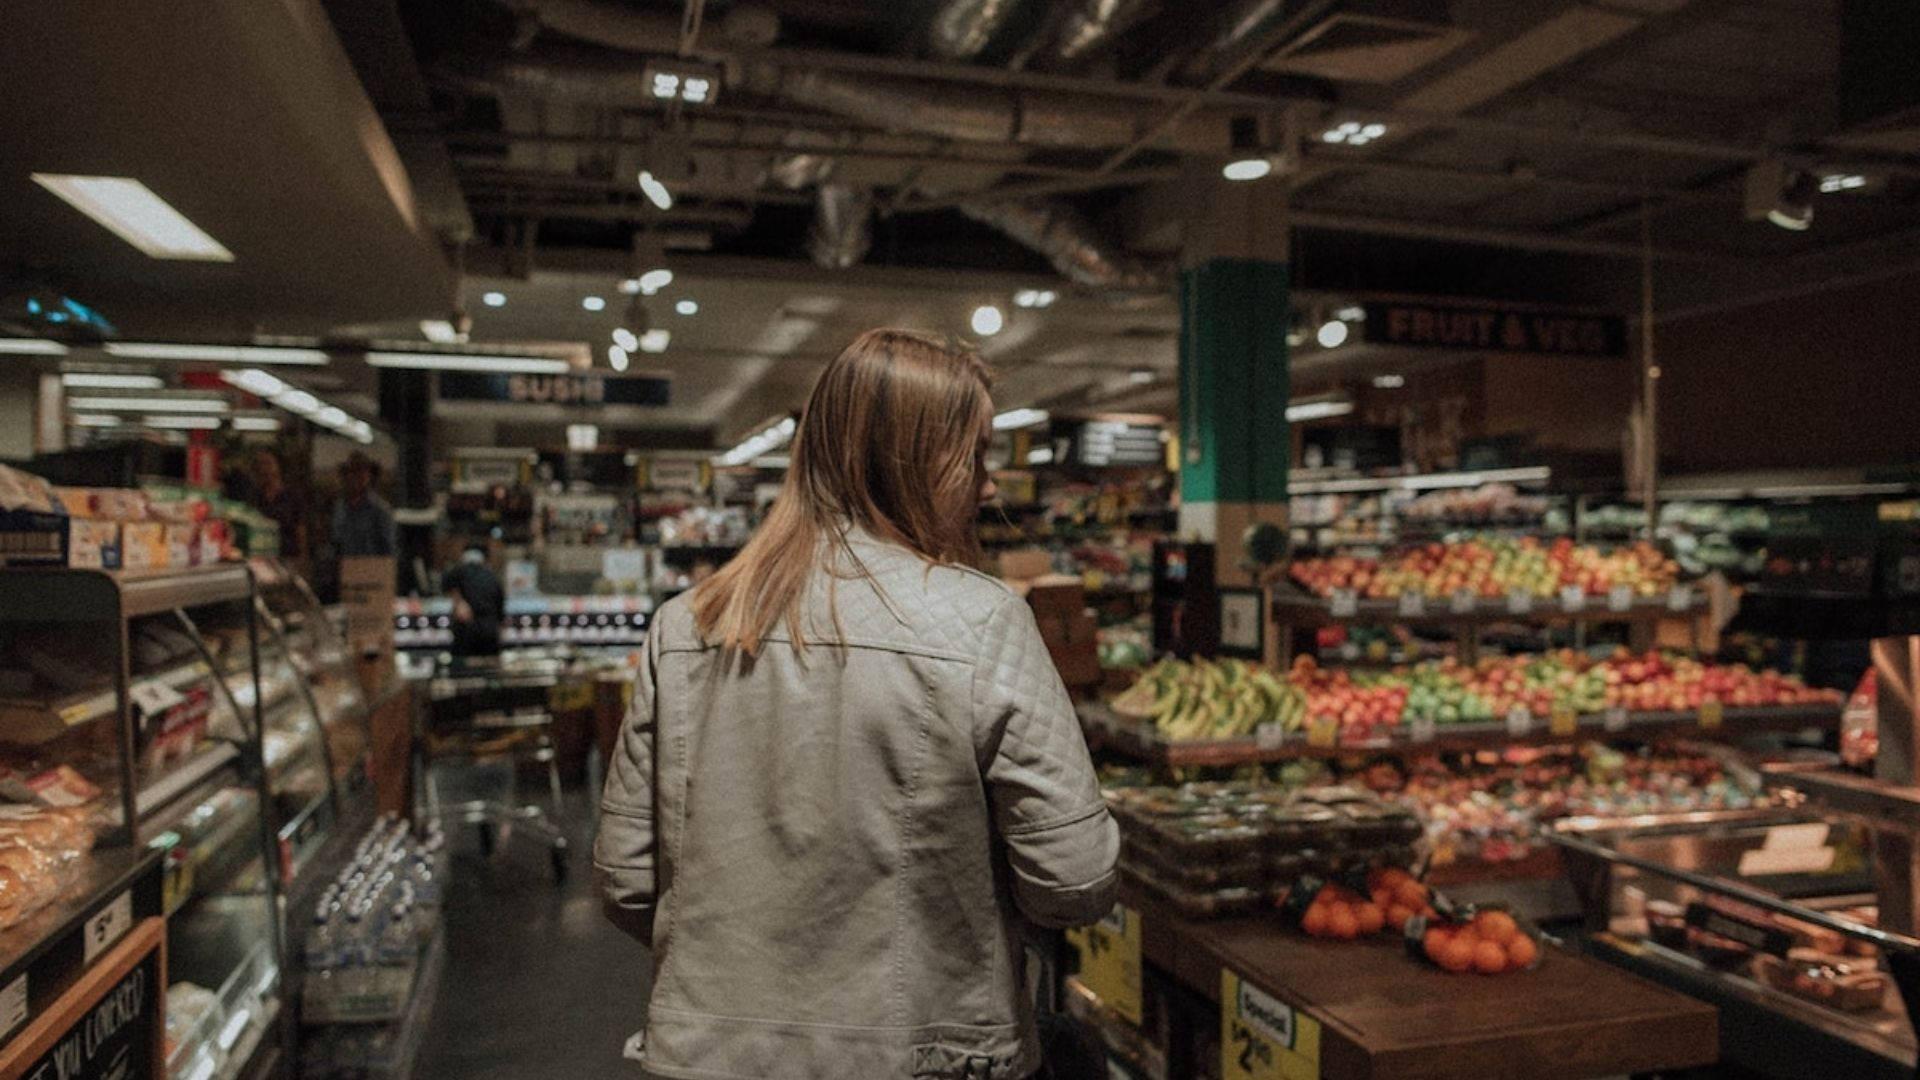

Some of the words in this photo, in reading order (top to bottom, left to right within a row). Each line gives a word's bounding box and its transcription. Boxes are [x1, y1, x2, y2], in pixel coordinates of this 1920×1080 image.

[1388, 308, 1495, 345] FRUIT
[1502, 313, 1526, 346] &
[1532, 316, 1605, 351] VEG
[508, 375, 606, 401] SUSHI
[1243, 992, 1288, 1034] Special
[53, 1031, 81, 1080] YOU
